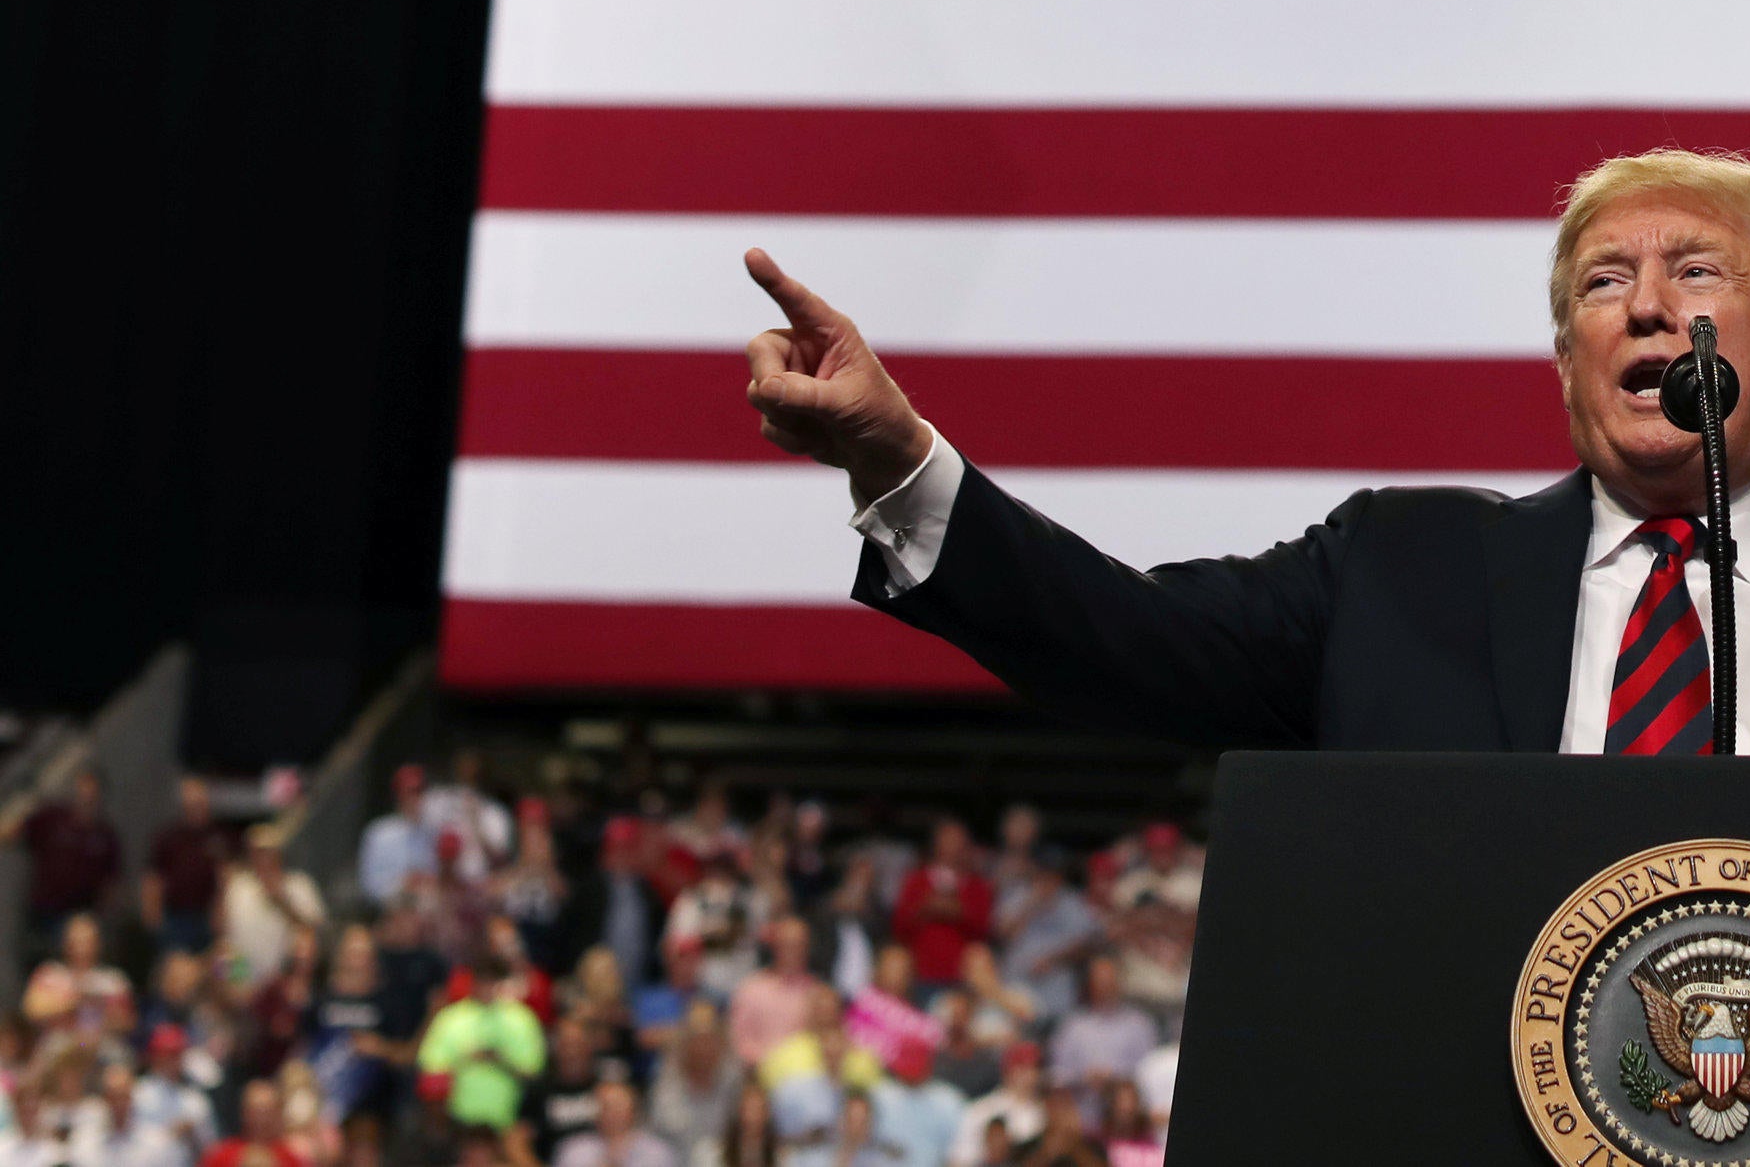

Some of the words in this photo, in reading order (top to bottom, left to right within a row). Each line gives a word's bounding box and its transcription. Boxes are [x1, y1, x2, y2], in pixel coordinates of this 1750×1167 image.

[1526, 853, 1705, 1025] PRESIDENT
[1684, 984, 1727, 996] PLURIBUS
[1530, 1040, 1560, 1095] THE
[1545, 1102, 1577, 1134] OF
